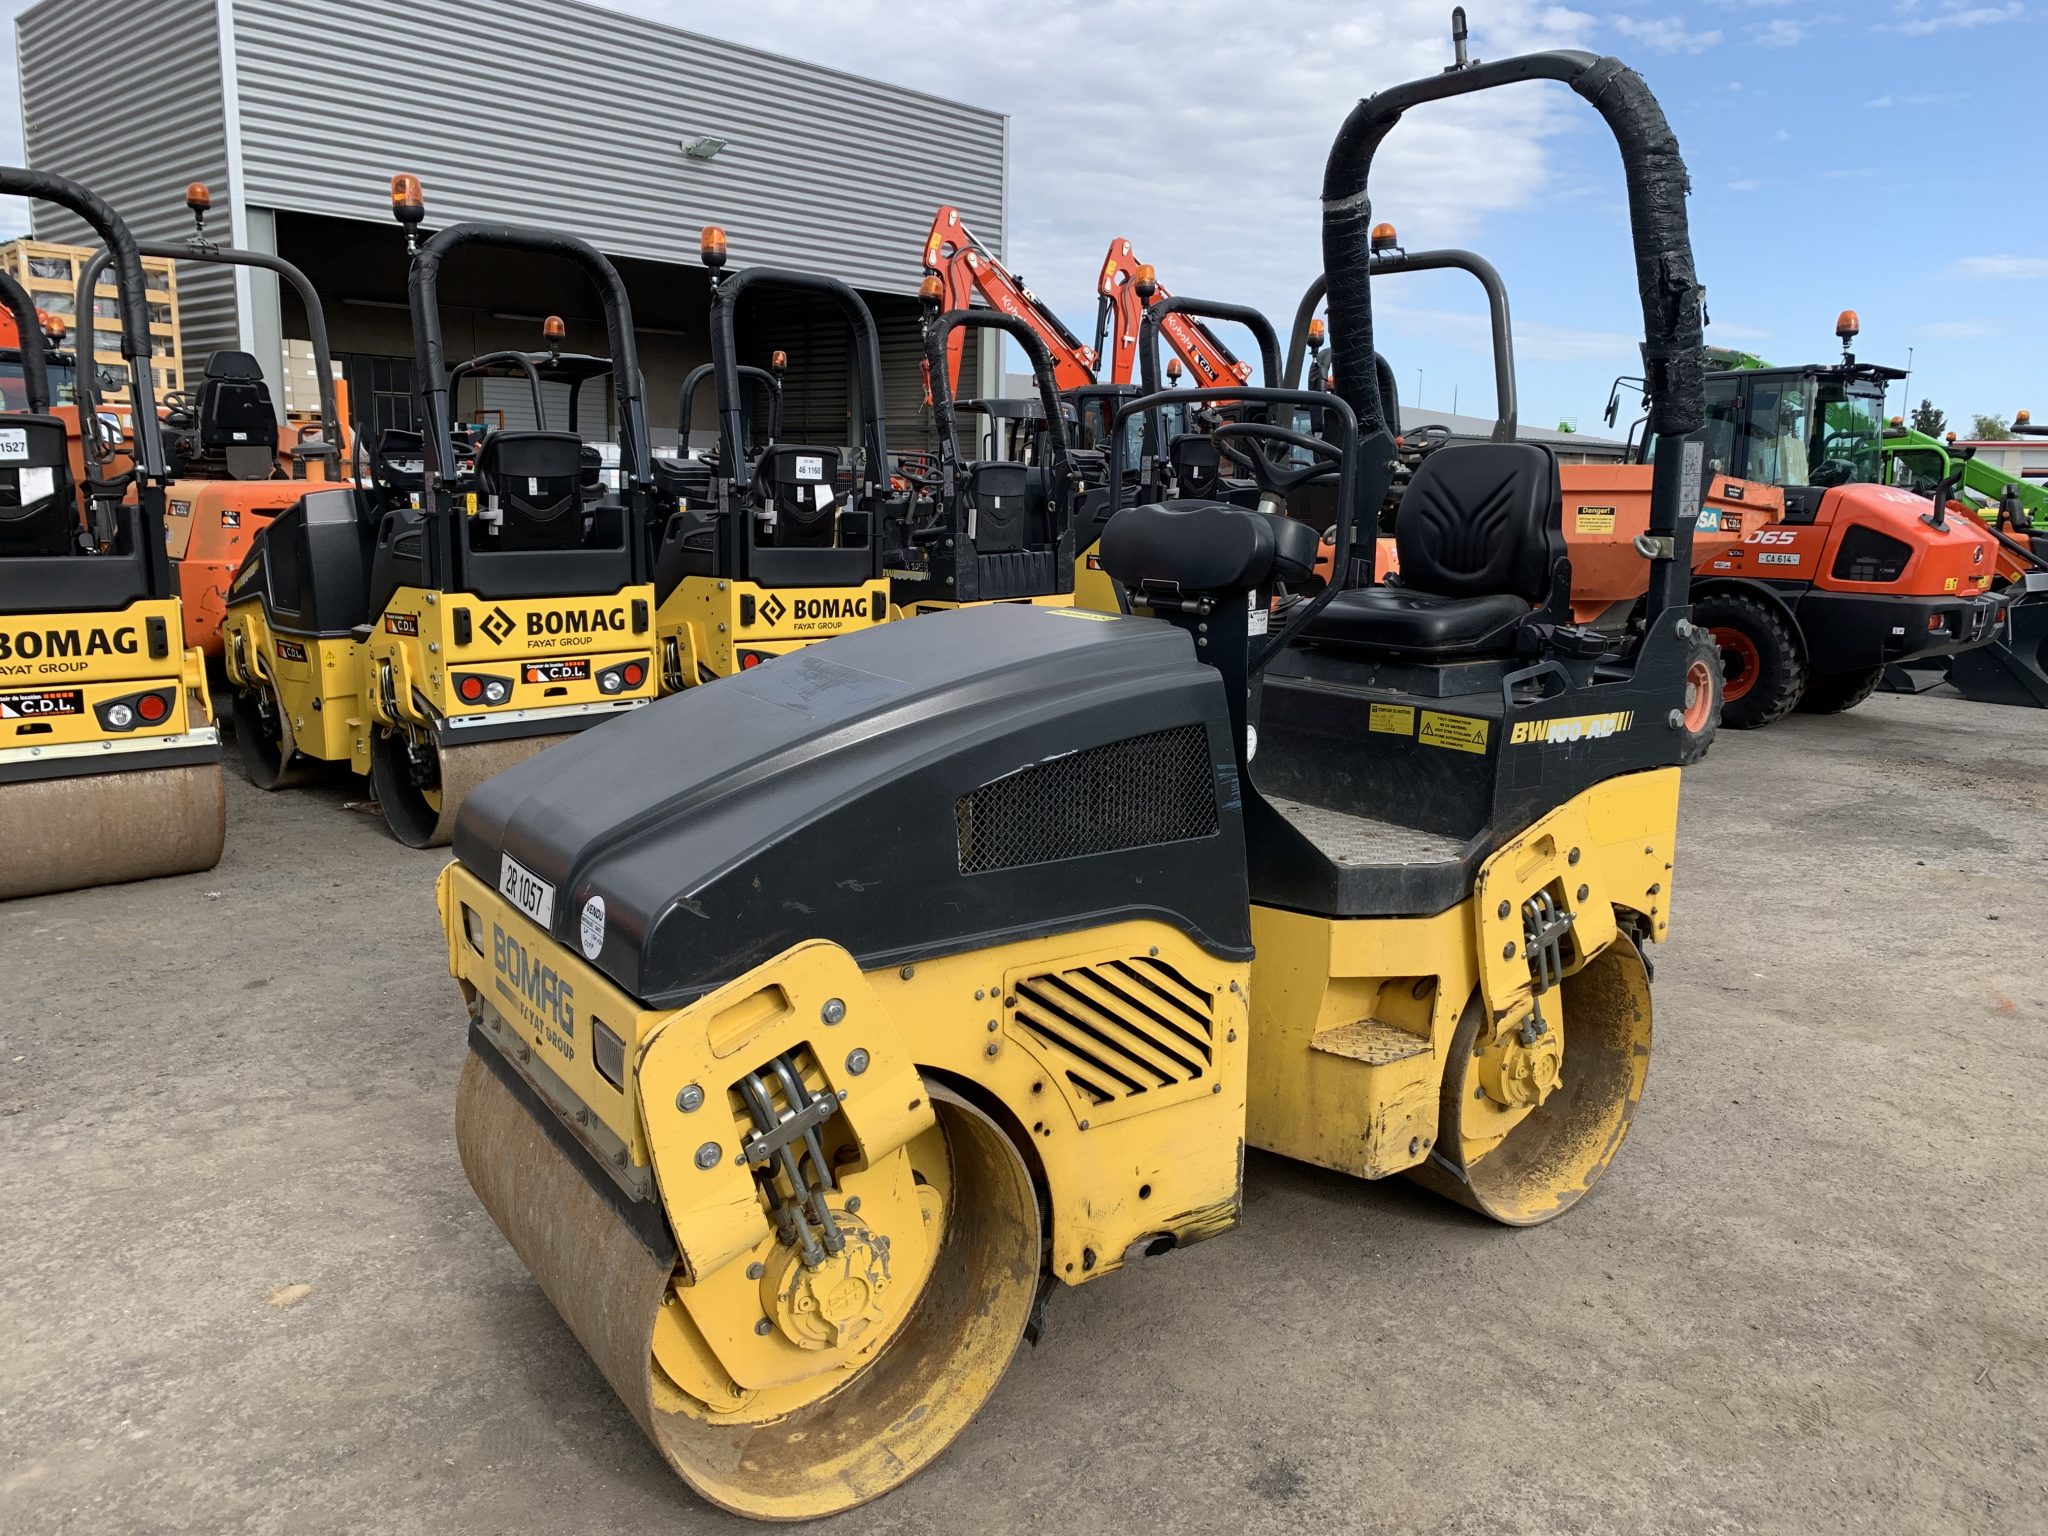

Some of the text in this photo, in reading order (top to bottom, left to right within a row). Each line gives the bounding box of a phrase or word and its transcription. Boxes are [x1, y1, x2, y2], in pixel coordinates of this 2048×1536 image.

[1168, 315, 1193, 350] Kubota
[1777, 555, 1792, 563] 614
[794, 598, 867, 620] BOMAG
[526, 608, 625, 636] BOMAG
[794, 622, 842, 631] FAYAT GROUP
[0, 627, 138, 660] BOMAG
[527, 637, 592, 649] FAYAT GROUP
[39, 662, 88, 673] GROUP
[550, 667, 585, 678] C.D.L.
[21, 699, 75, 713] C.D.L.
[506, 864, 544, 916] 2R 1057
[587, 902, 604, 921] VENDU
[493, 922, 574, 1040] BOMAG
[546, 1026, 575, 1062] GROUP
